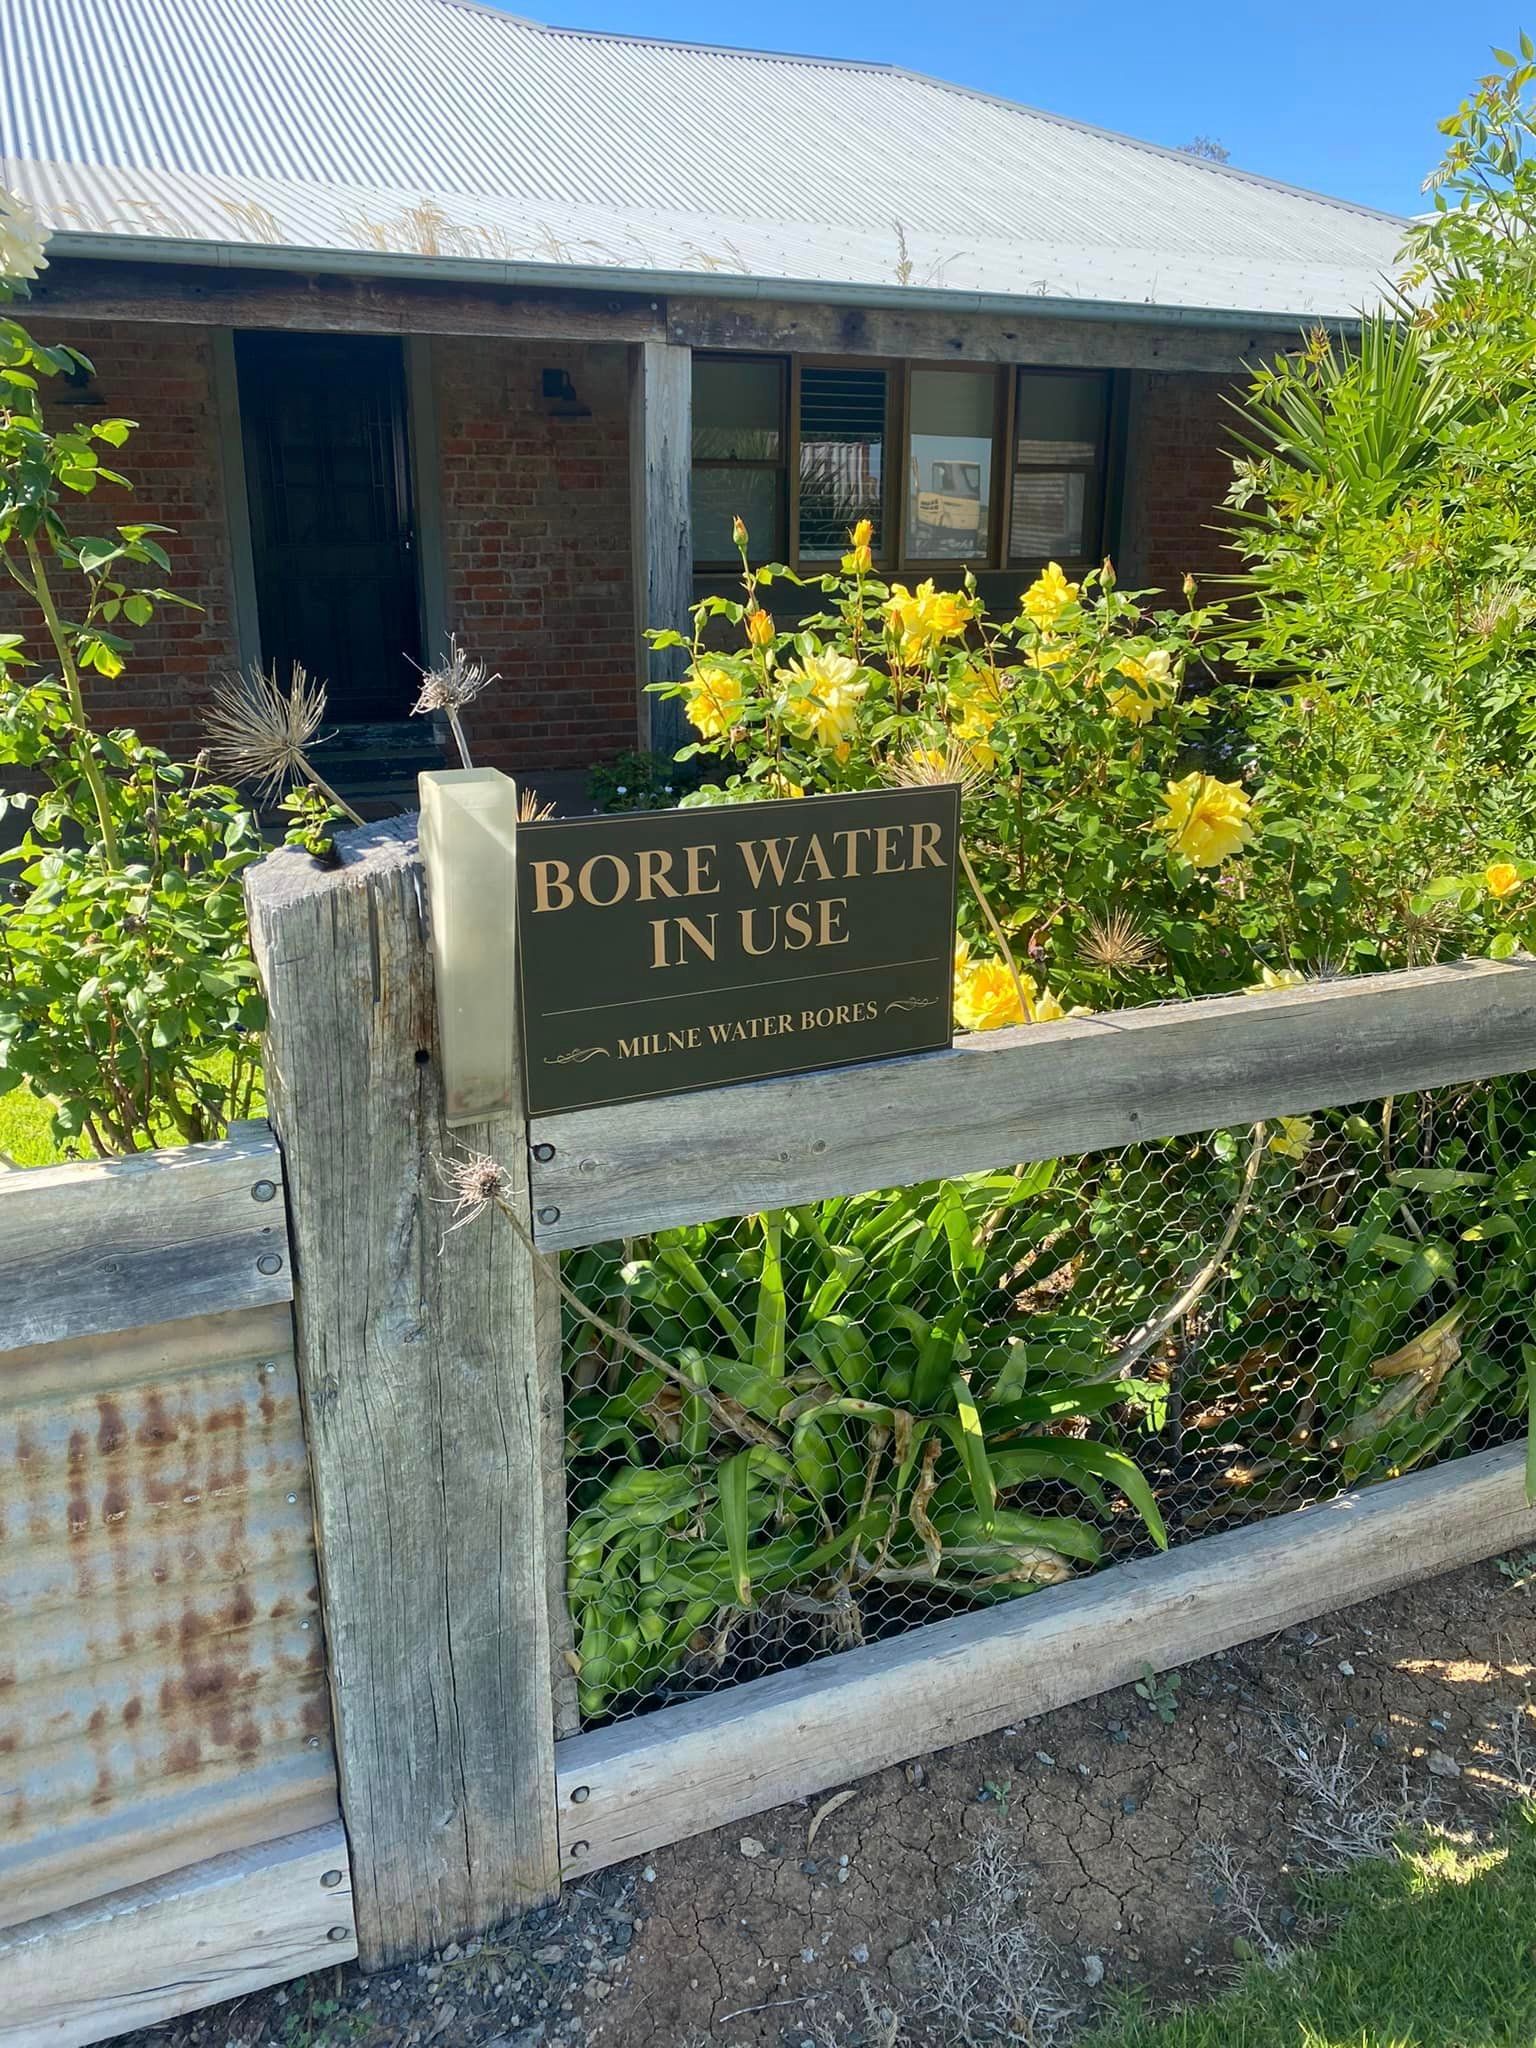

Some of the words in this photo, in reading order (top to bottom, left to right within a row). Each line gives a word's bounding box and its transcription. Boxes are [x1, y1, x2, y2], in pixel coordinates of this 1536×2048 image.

[529, 845, 720, 913] BORE
[735, 822, 948, 889] WATER
[649, 913, 719, 969] IN
[737, 898, 849, 955] USE
[617, 1027, 701, 1059] MILNE
[708, 1014, 794, 1044] WATER
[800, 1001, 878, 1031] BORES
